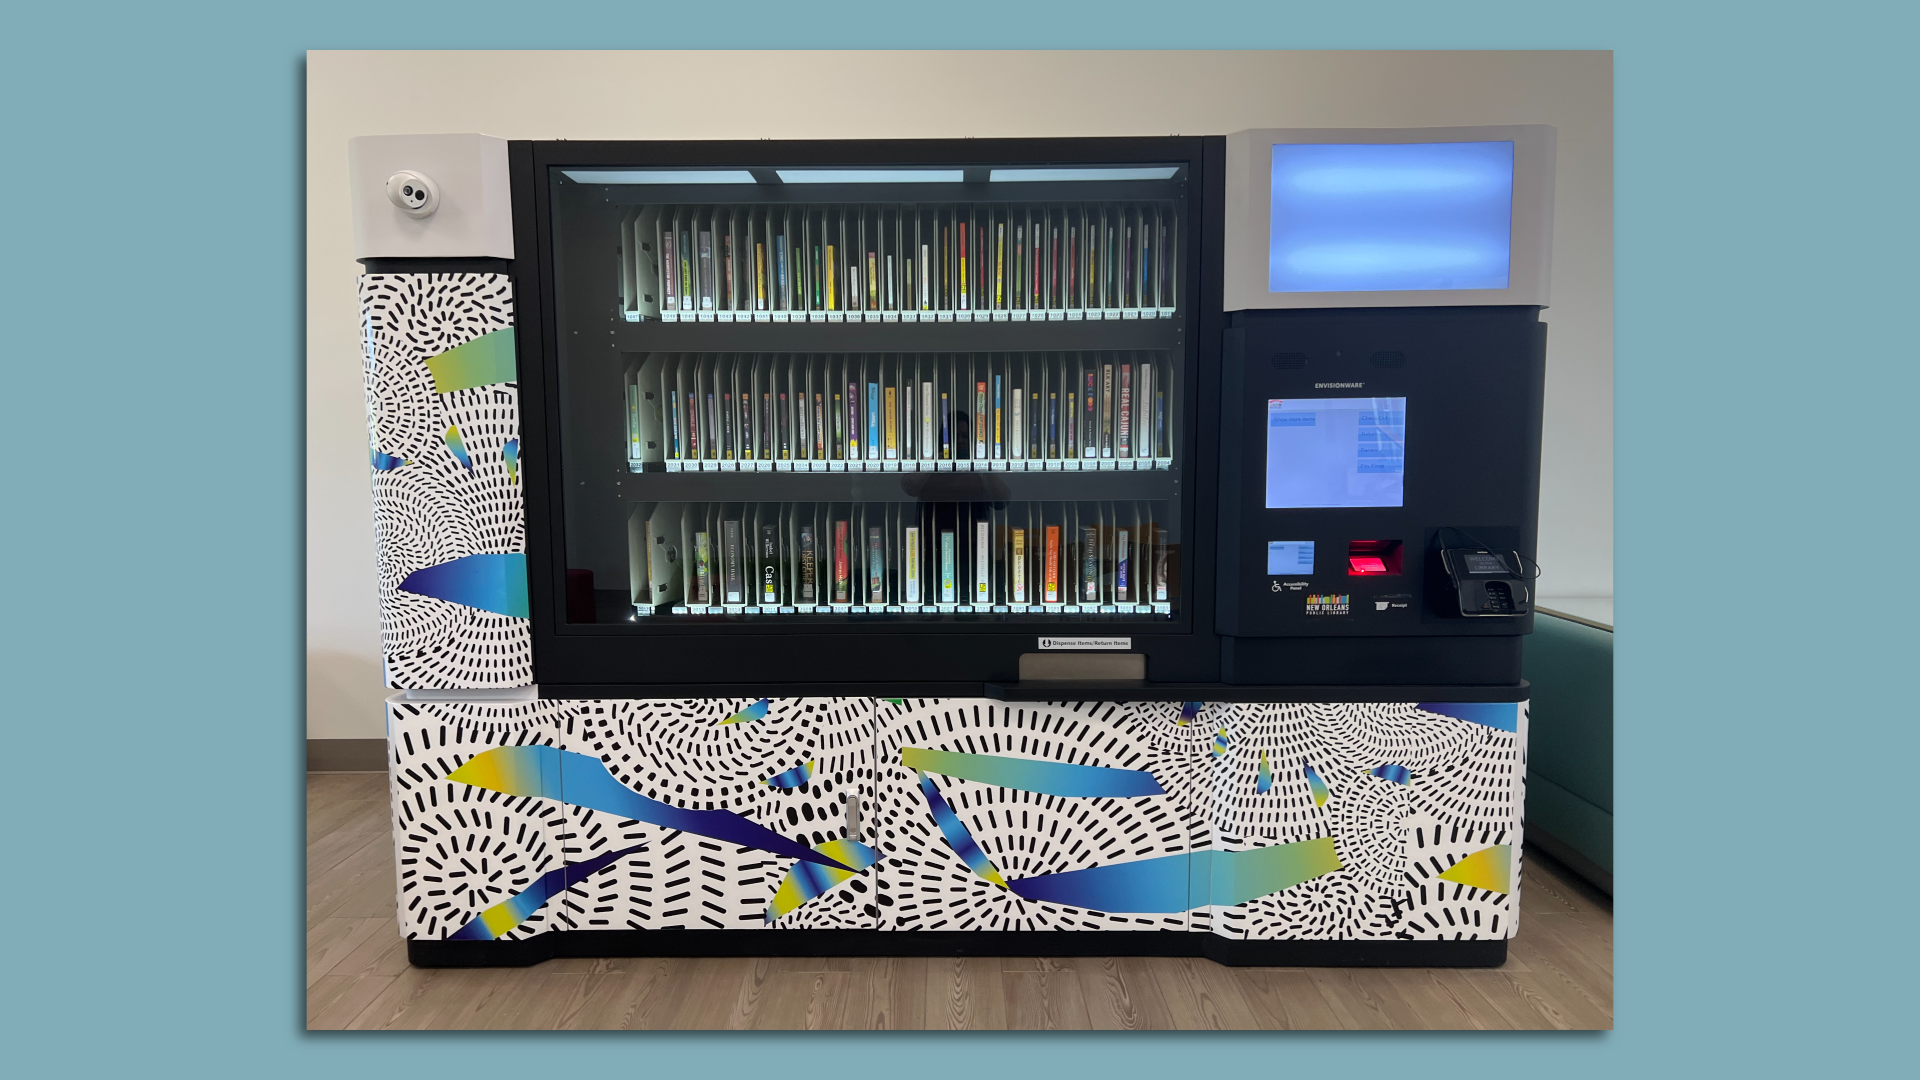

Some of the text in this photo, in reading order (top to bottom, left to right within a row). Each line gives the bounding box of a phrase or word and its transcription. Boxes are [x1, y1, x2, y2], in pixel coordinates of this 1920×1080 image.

[1121, 388, 1130, 435] REAL CAJUN
[765, 566, 775, 584] Cas
